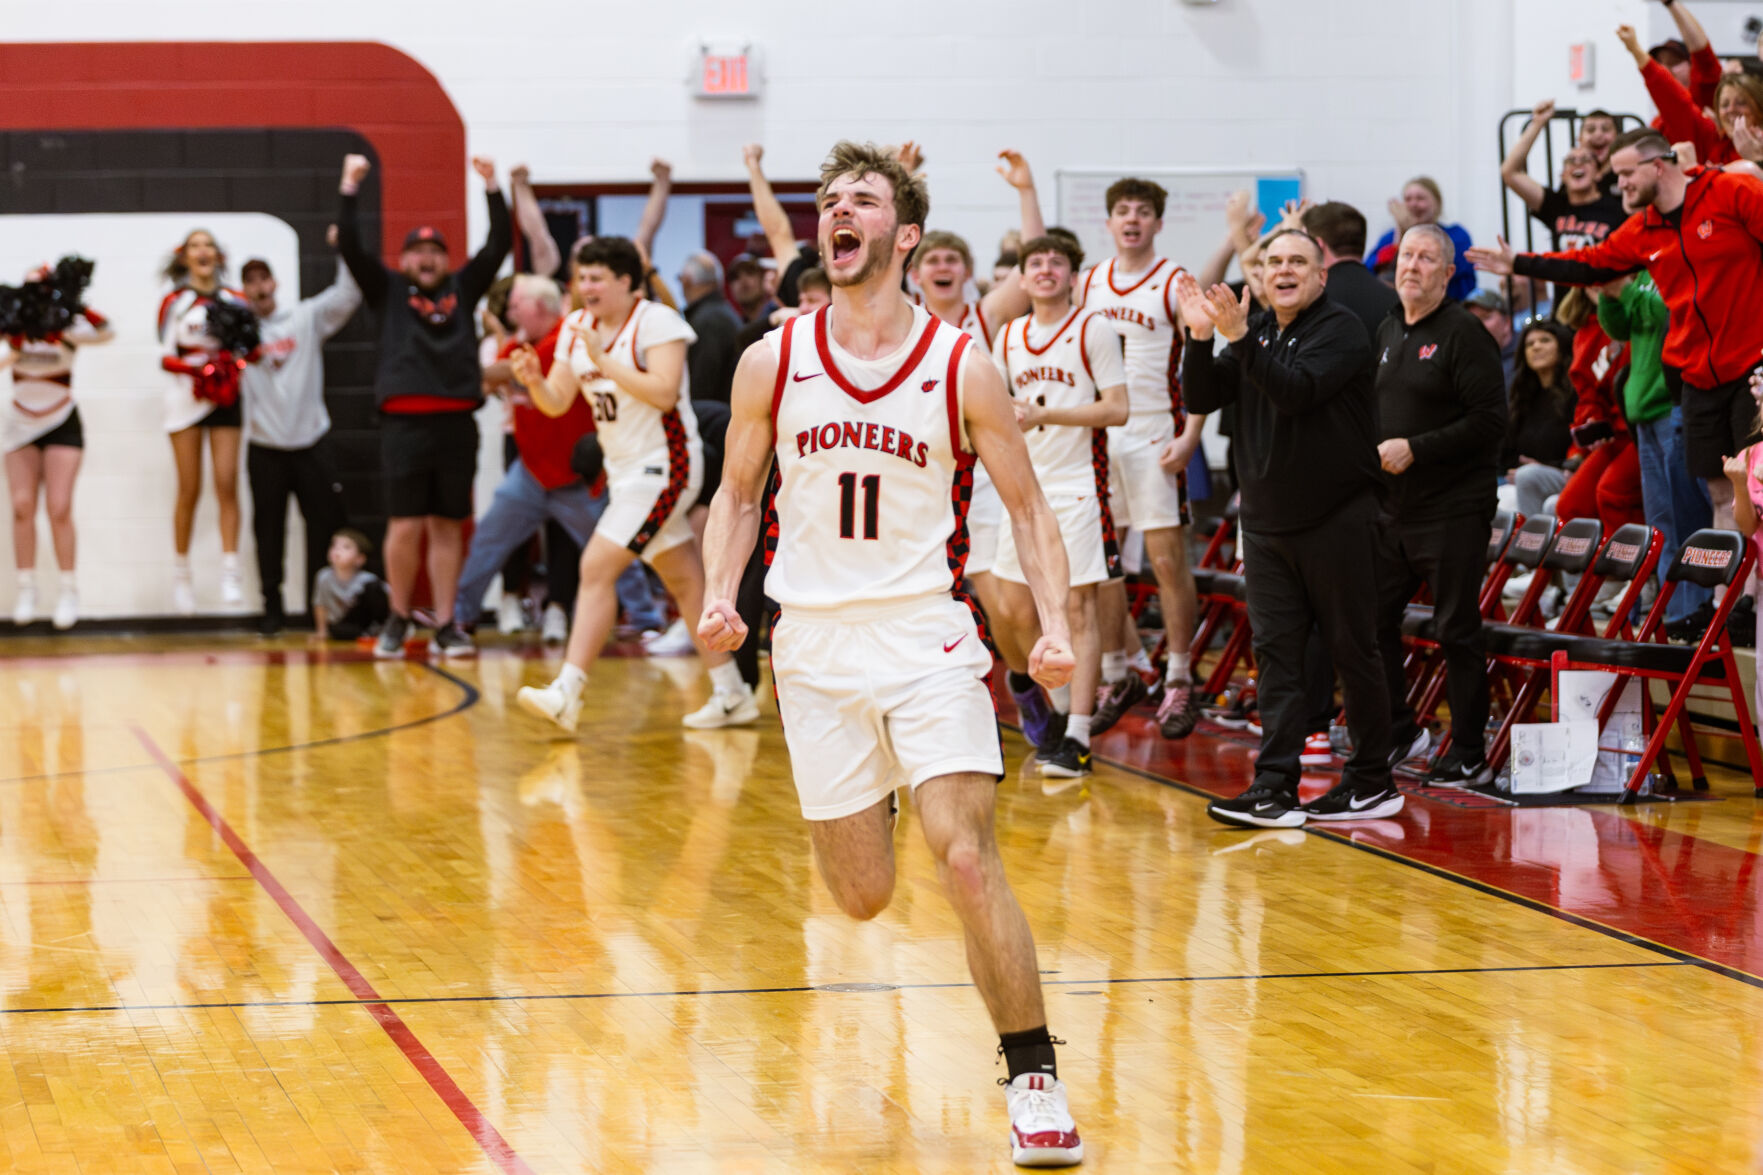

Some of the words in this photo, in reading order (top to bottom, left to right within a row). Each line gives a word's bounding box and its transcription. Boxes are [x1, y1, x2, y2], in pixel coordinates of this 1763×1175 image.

[704, 56, 748, 93] EXIT
[796, 421, 929, 468] PIONEERS
[838, 471, 881, 541] 11
[1681, 546, 1733, 568] PIONEERS
